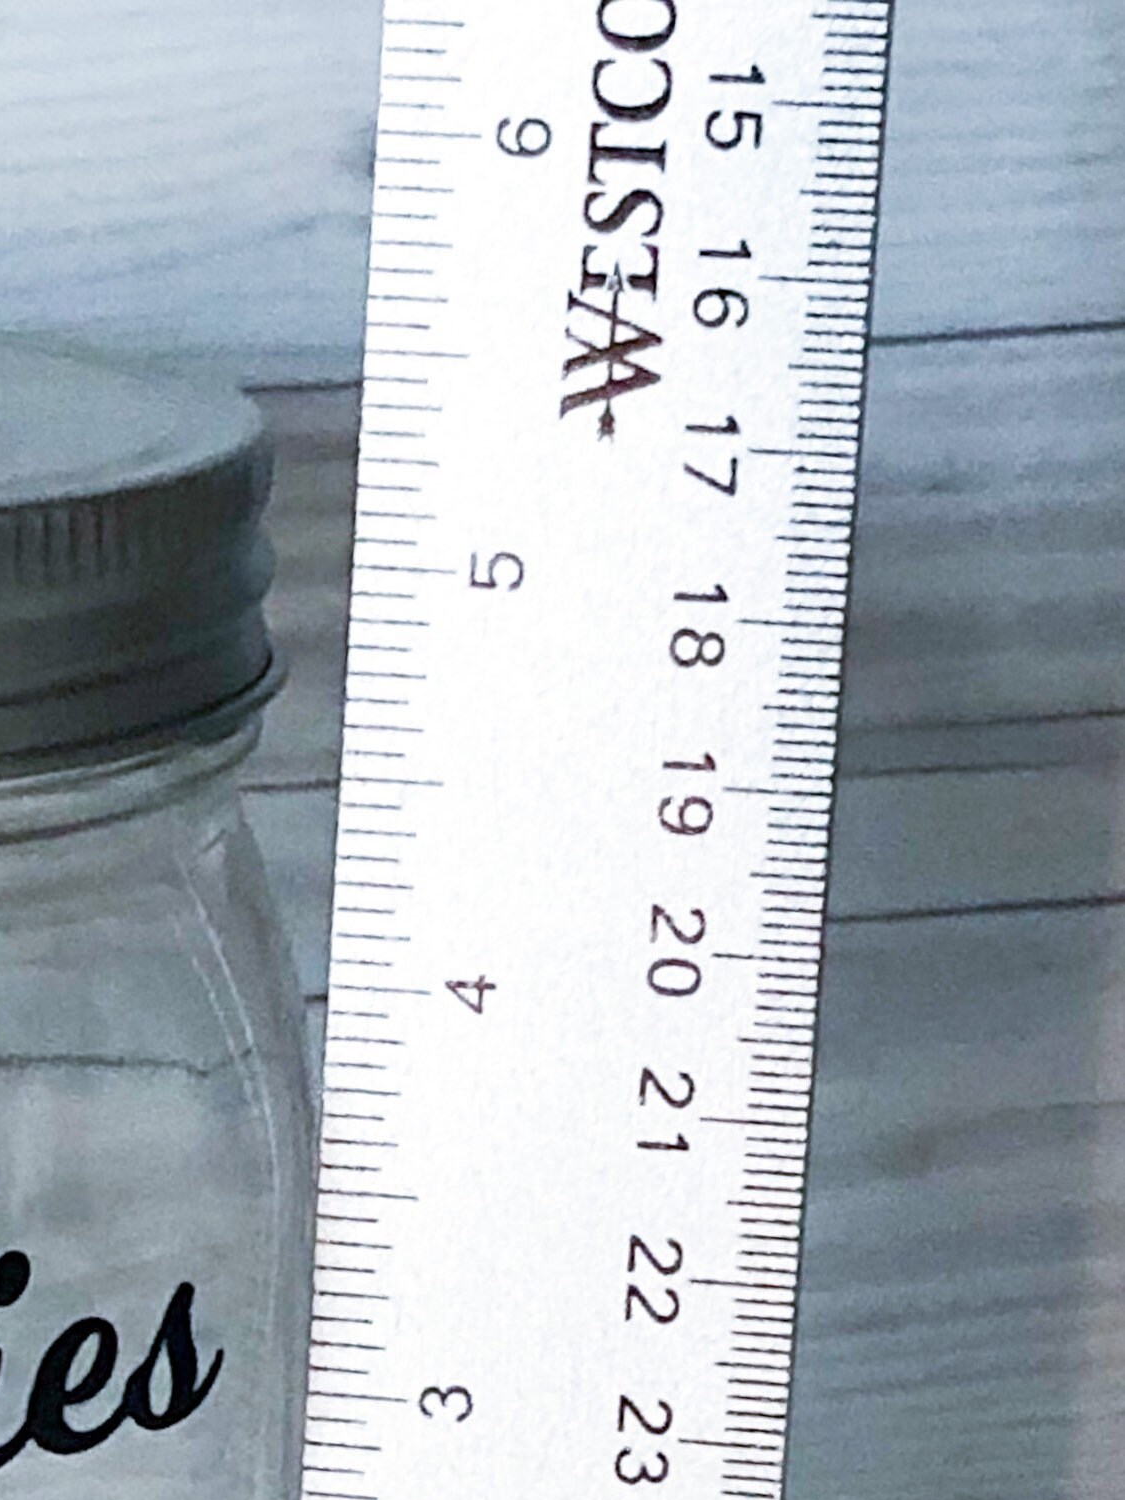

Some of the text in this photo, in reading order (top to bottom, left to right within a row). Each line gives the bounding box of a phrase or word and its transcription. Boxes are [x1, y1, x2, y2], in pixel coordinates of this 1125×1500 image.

[495, 117, 553, 158] 6
[704, 63, 767, 152] 15
[692, 239, 753, 329] 16
[683, 414, 741, 497] 17
[469, 551, 525, 590] 5
[668, 583, 730, 669] 18
[657, 752, 717, 837] 19
[646, 903, 706, 998] 20
[444, 975, 497, 1015] 4
[636, 1066, 696, 1152] 21
[624, 1233, 684, 1325] 22
[418, 1384, 474, 1423] 3
[613, 1393, 674, 1486] 23
